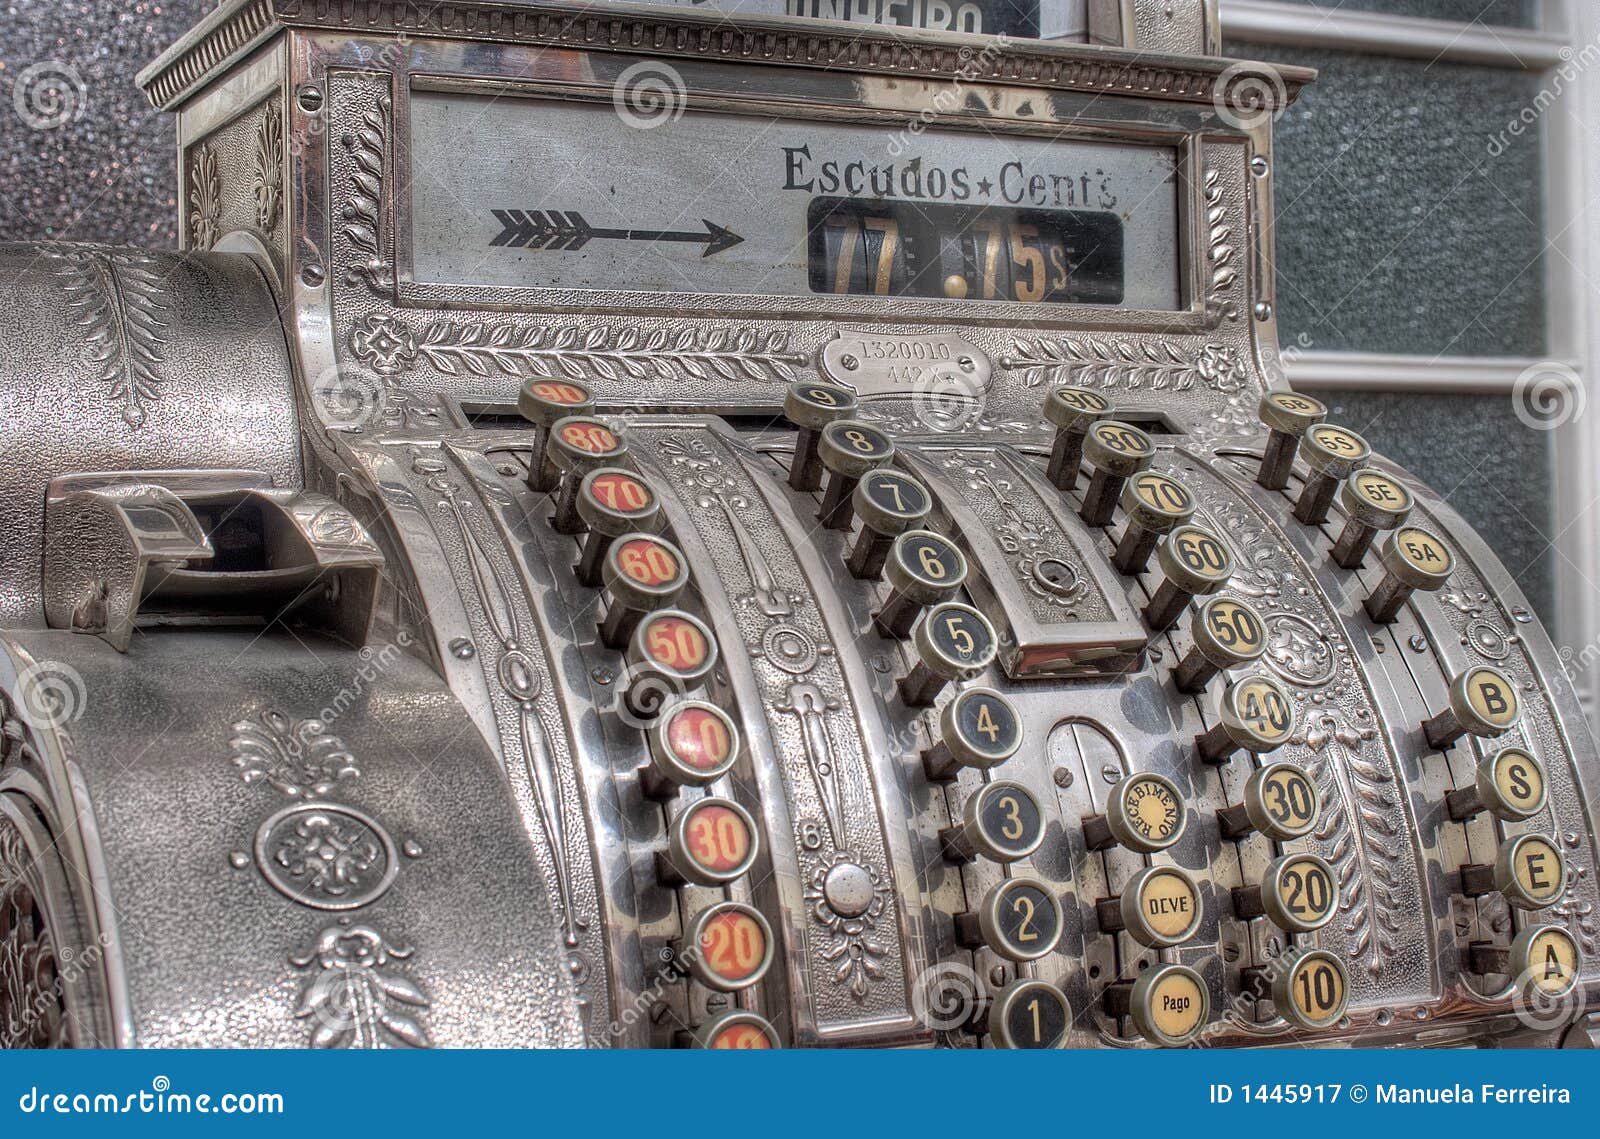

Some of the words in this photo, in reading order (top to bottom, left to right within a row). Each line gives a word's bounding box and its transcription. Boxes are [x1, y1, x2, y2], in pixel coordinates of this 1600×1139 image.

[781, 143, 971, 200] Escudos
[859, 341, 950, 360] 1320010
[532, 383, 580, 404] 90
[809, 389, 837, 407] 9
[1058, 390, 1109, 411] 90
[562, 425, 619, 451] 80
[845, 430, 872, 453] 8
[1098, 430, 1148, 452] 80
[1319, 435, 1354, 450] 5S
[595, 480, 649, 511] 70
[880, 484, 906, 511] 7
[1138, 482, 1186, 510] 70
[1363, 483, 1398, 502] 5E
[622, 542, 677, 584] 60
[918, 546, 945, 580] 6
[1180, 538, 1226, 571] 60
[1405, 540, 1441, 564] 5A
[946, 617, 975, 653] 5
[1209, 608, 1259, 646] 50
[647, 624, 700, 667] 50
[1243, 690, 1290, 732] 40
[1479, 683, 1508, 715] B
[977, 703, 1000, 742] 4
[1265, 777, 1312, 822] 30
[1508, 764, 1532, 800] S
[998, 796, 1024, 840] 3
[689, 815, 747, 868] 30
[1526, 853, 1550, 889] E
[1283, 869, 1327, 914] 20
[1013, 896, 1037, 941] 2
[708, 920, 766, 971] 20
[1543, 944, 1565, 981] A
[1163, 995, 1190, 1013] Pago
[1299, 966, 1336, 1013] 10
[1026, 999, 1041, 1042] 1
